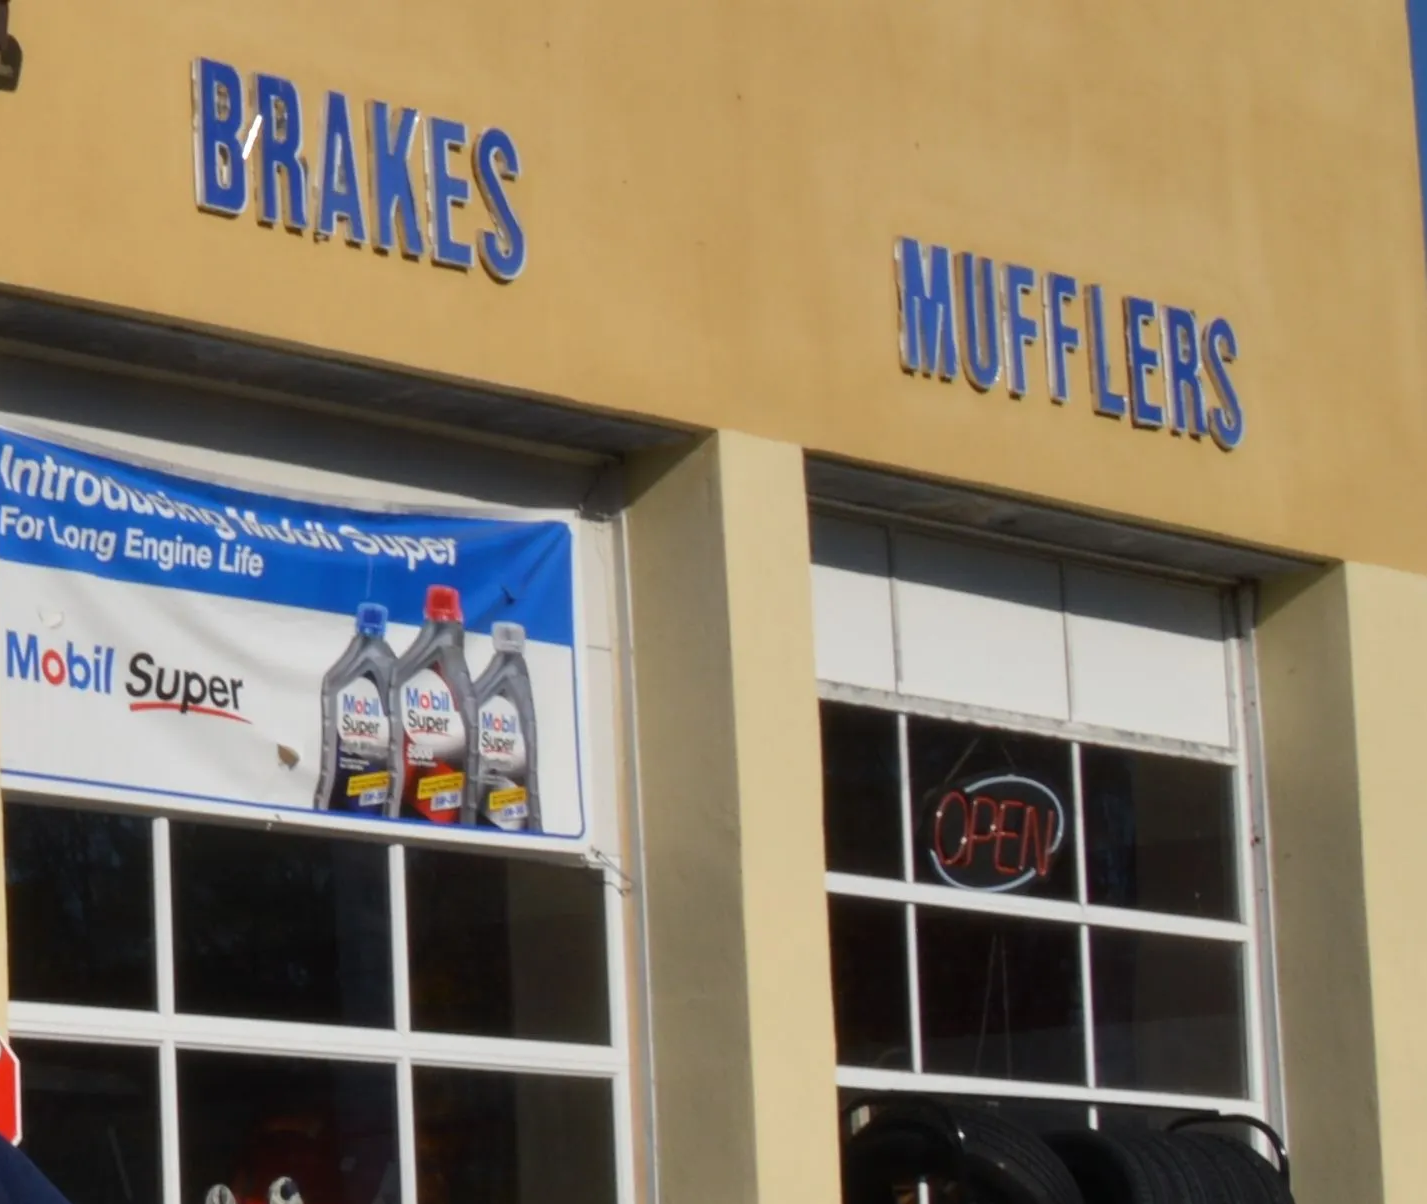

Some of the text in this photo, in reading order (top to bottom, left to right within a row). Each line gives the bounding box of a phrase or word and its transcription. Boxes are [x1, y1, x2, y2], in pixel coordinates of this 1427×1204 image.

[191, 57, 526, 281] BRAKES
[895, 236, 1245, 450] MUFFLERS
[0, 444, 236, 541] Introducing
[338, 524, 457, 571] Super
[0, 505, 264, 577] For Long Engine Life
[5, 629, 244, 714] Mobil Super
[343, 693, 381, 716] Mobil
[406, 688, 451, 712] Mobil
[408, 710, 450, 733] Super
[482, 711, 517, 733] Mobil
[342, 714, 380, 736] Super
[481, 731, 515, 751] Super
[934, 789, 1055, 876] OPEN
